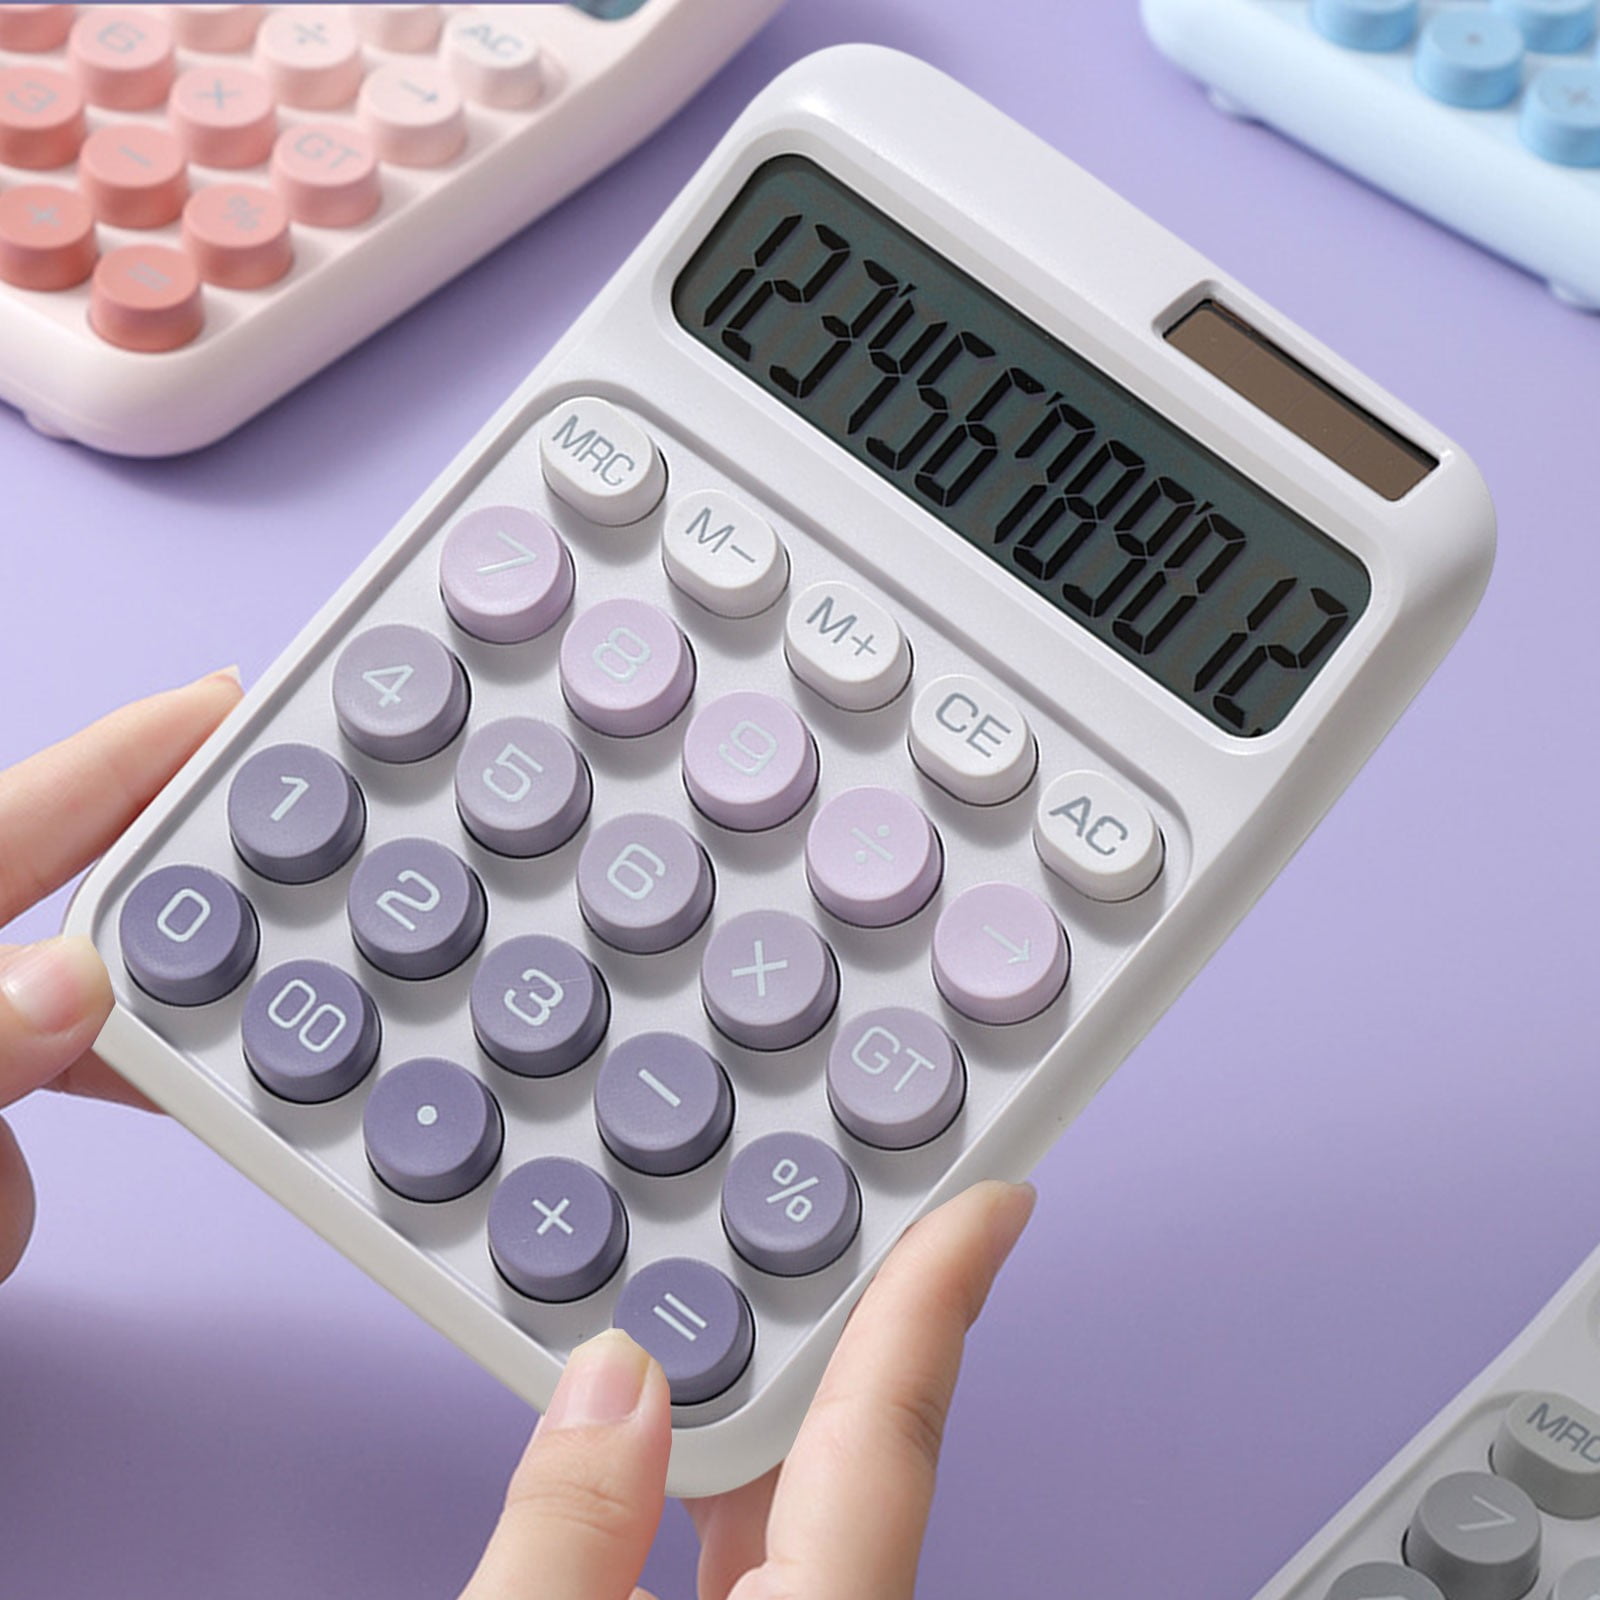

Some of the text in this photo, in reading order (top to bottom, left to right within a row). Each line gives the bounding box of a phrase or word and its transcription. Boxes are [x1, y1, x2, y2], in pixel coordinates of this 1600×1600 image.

[460, 23, 524, 58] AC
[294, 132, 364, 168] GT
[552, 415, 635, 486] MRC
[475, 530, 538, 575] 7
[593, 627, 651, 683] 8
[806, 596, 877, 657] M+
[362, 664, 415, 708] 4
[718, 720, 778, 776] 9
[935, 692, 1012, 758] CE
[270, 775, 310, 822] 1
[482, 743, 544, 802] 5
[1048, 795, 1129, 856] AC
[607, 843, 666, 900] 6
[156, 888, 211, 943] 0
[375, 870, 441, 931] 2
[267, 979, 347, 1053] 00
[503, 969, 564, 1027] 3
[851, 1026, 936, 1093] GT
